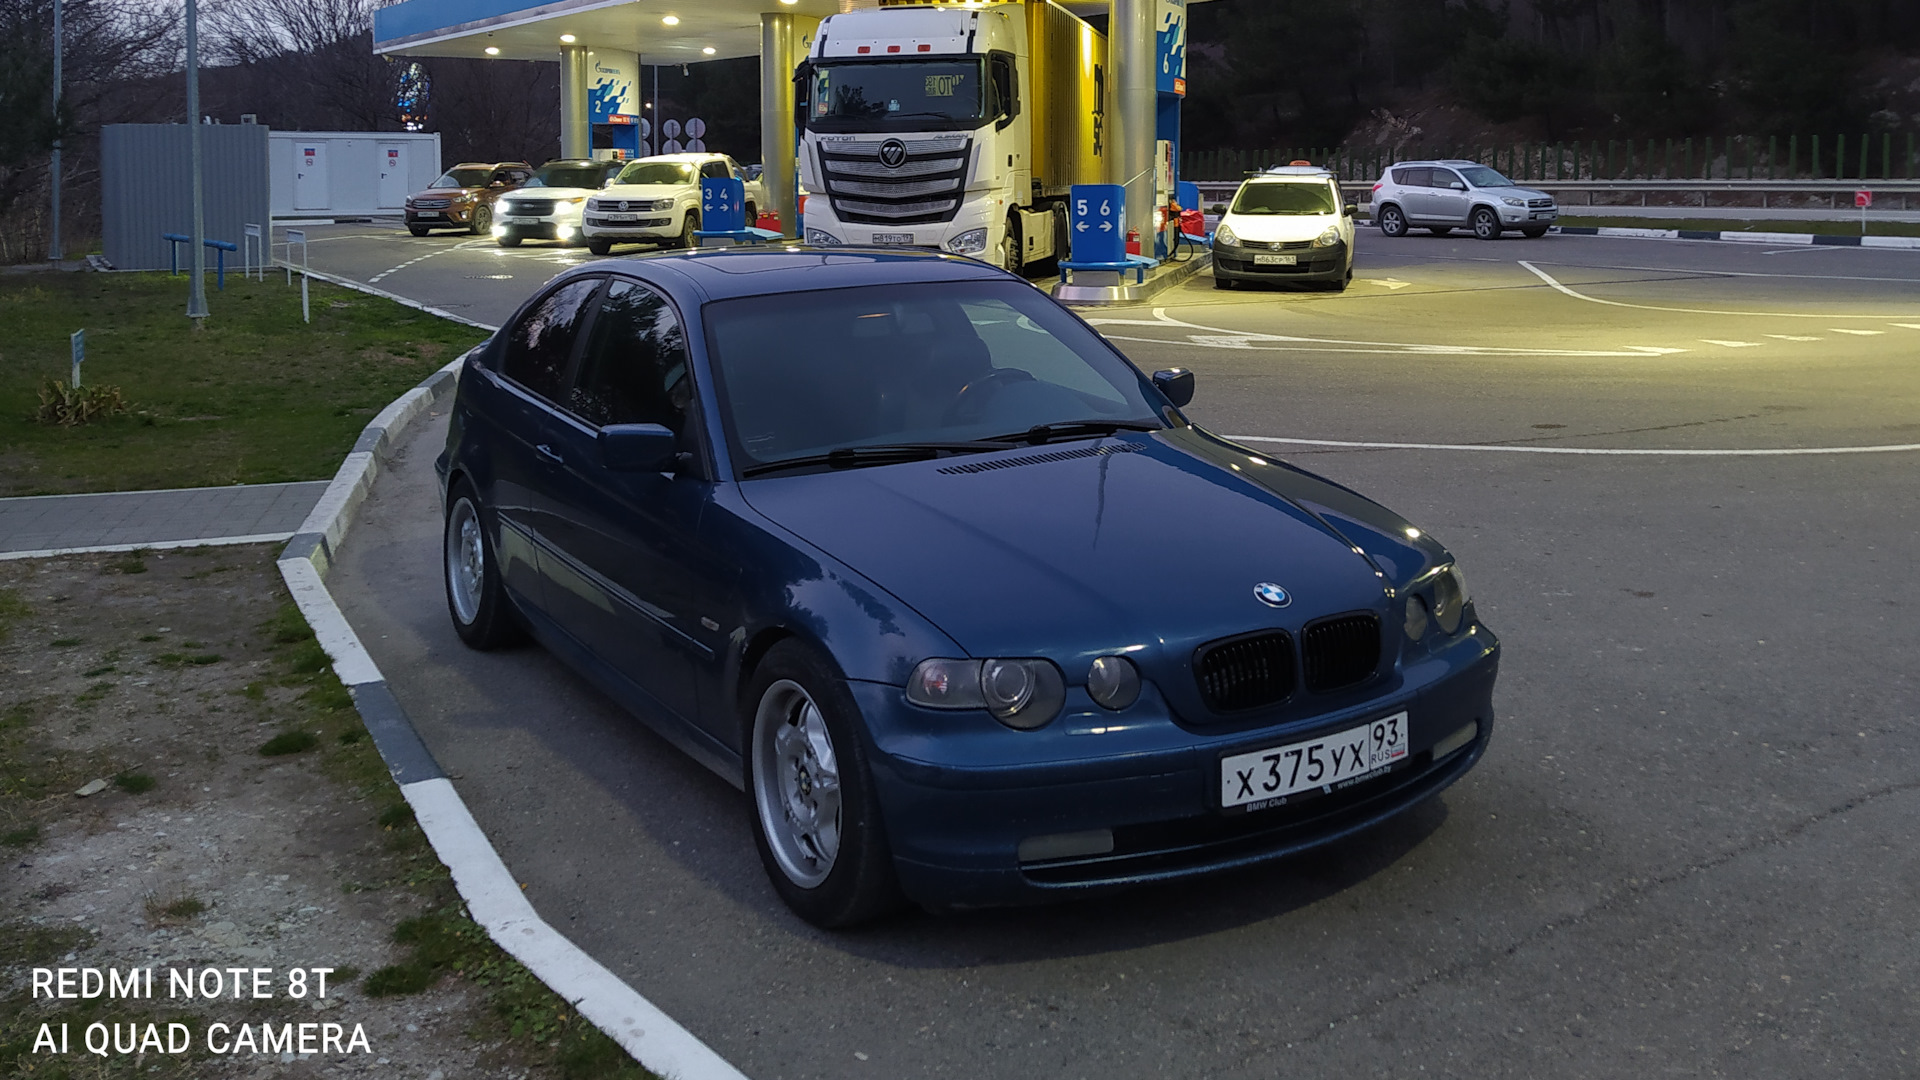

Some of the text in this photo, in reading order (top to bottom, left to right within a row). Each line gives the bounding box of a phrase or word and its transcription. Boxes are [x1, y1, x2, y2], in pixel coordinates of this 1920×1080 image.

[1163, 53, 1169, 74] 6
[595, 100, 602, 113] 2
[705, 188, 728, 200] 3 4
[1077, 199, 1111, 216] 5 6
[1372, 717, 1398, 751] 93
[1371, 749, 1391, 765] RUS
[1246, 796, 1288, 812] BMW Club
